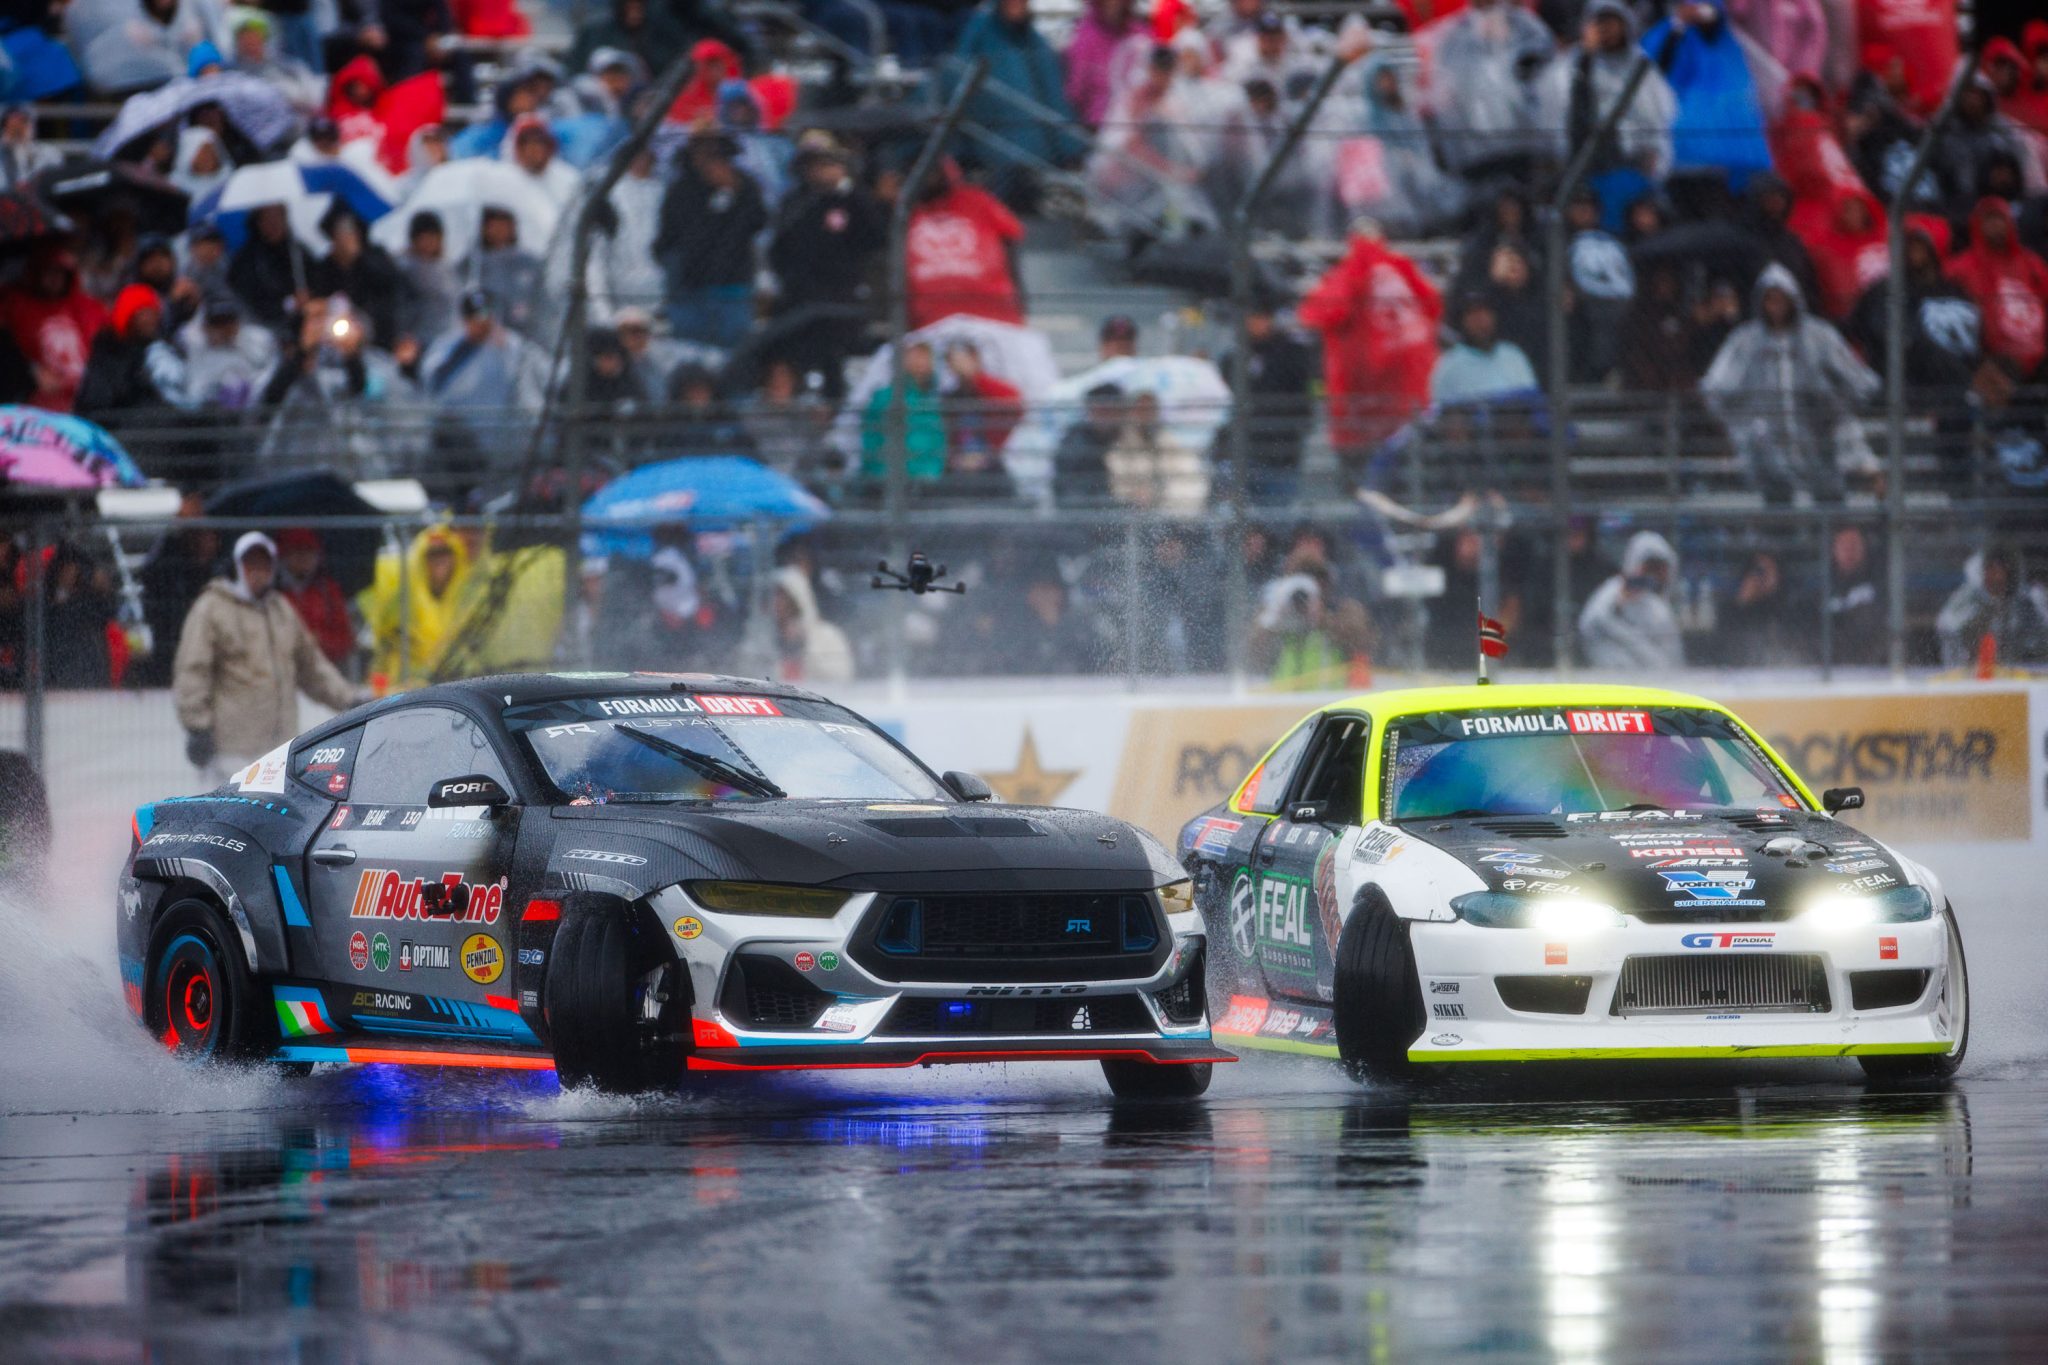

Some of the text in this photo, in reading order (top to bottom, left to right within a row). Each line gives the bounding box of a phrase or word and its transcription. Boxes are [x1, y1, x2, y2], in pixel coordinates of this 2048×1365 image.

[598, 697, 774, 716] FORMULA DRIFT
[1461, 712, 1646, 736] FORMULA DRIFT
[310, 747, 346, 764] FORD
[1778, 727, 1998, 783] OCKSTAR
[441, 782, 496, 799] FORD
[361, 809, 390, 827] DEANE
[400, 811, 423, 826] 130
[1565, 809, 1703, 822] FEAL
[187, 833, 247, 853] VEHICLES
[1358, 826, 1402, 854] PEDAL
[1620, 839, 1684, 847] Holley
[1527, 881, 1581, 896] FEAL
[1853, 872, 1896, 890] FEAL
[1260, 878, 1312, 946] FEAL
[1674, 900, 1766, 908] SUPERCHARGERS
[352, 941, 365, 949] NGK
[375, 943, 387, 951] NTK
[413, 945, 450, 968] OPTIMA
[466, 949, 499, 969] PENNZOIL
[965, 984, 1089, 996] NITTO
[375, 994, 412, 1010] RACING
[1433, 1004, 1465, 1017] SIKKY
